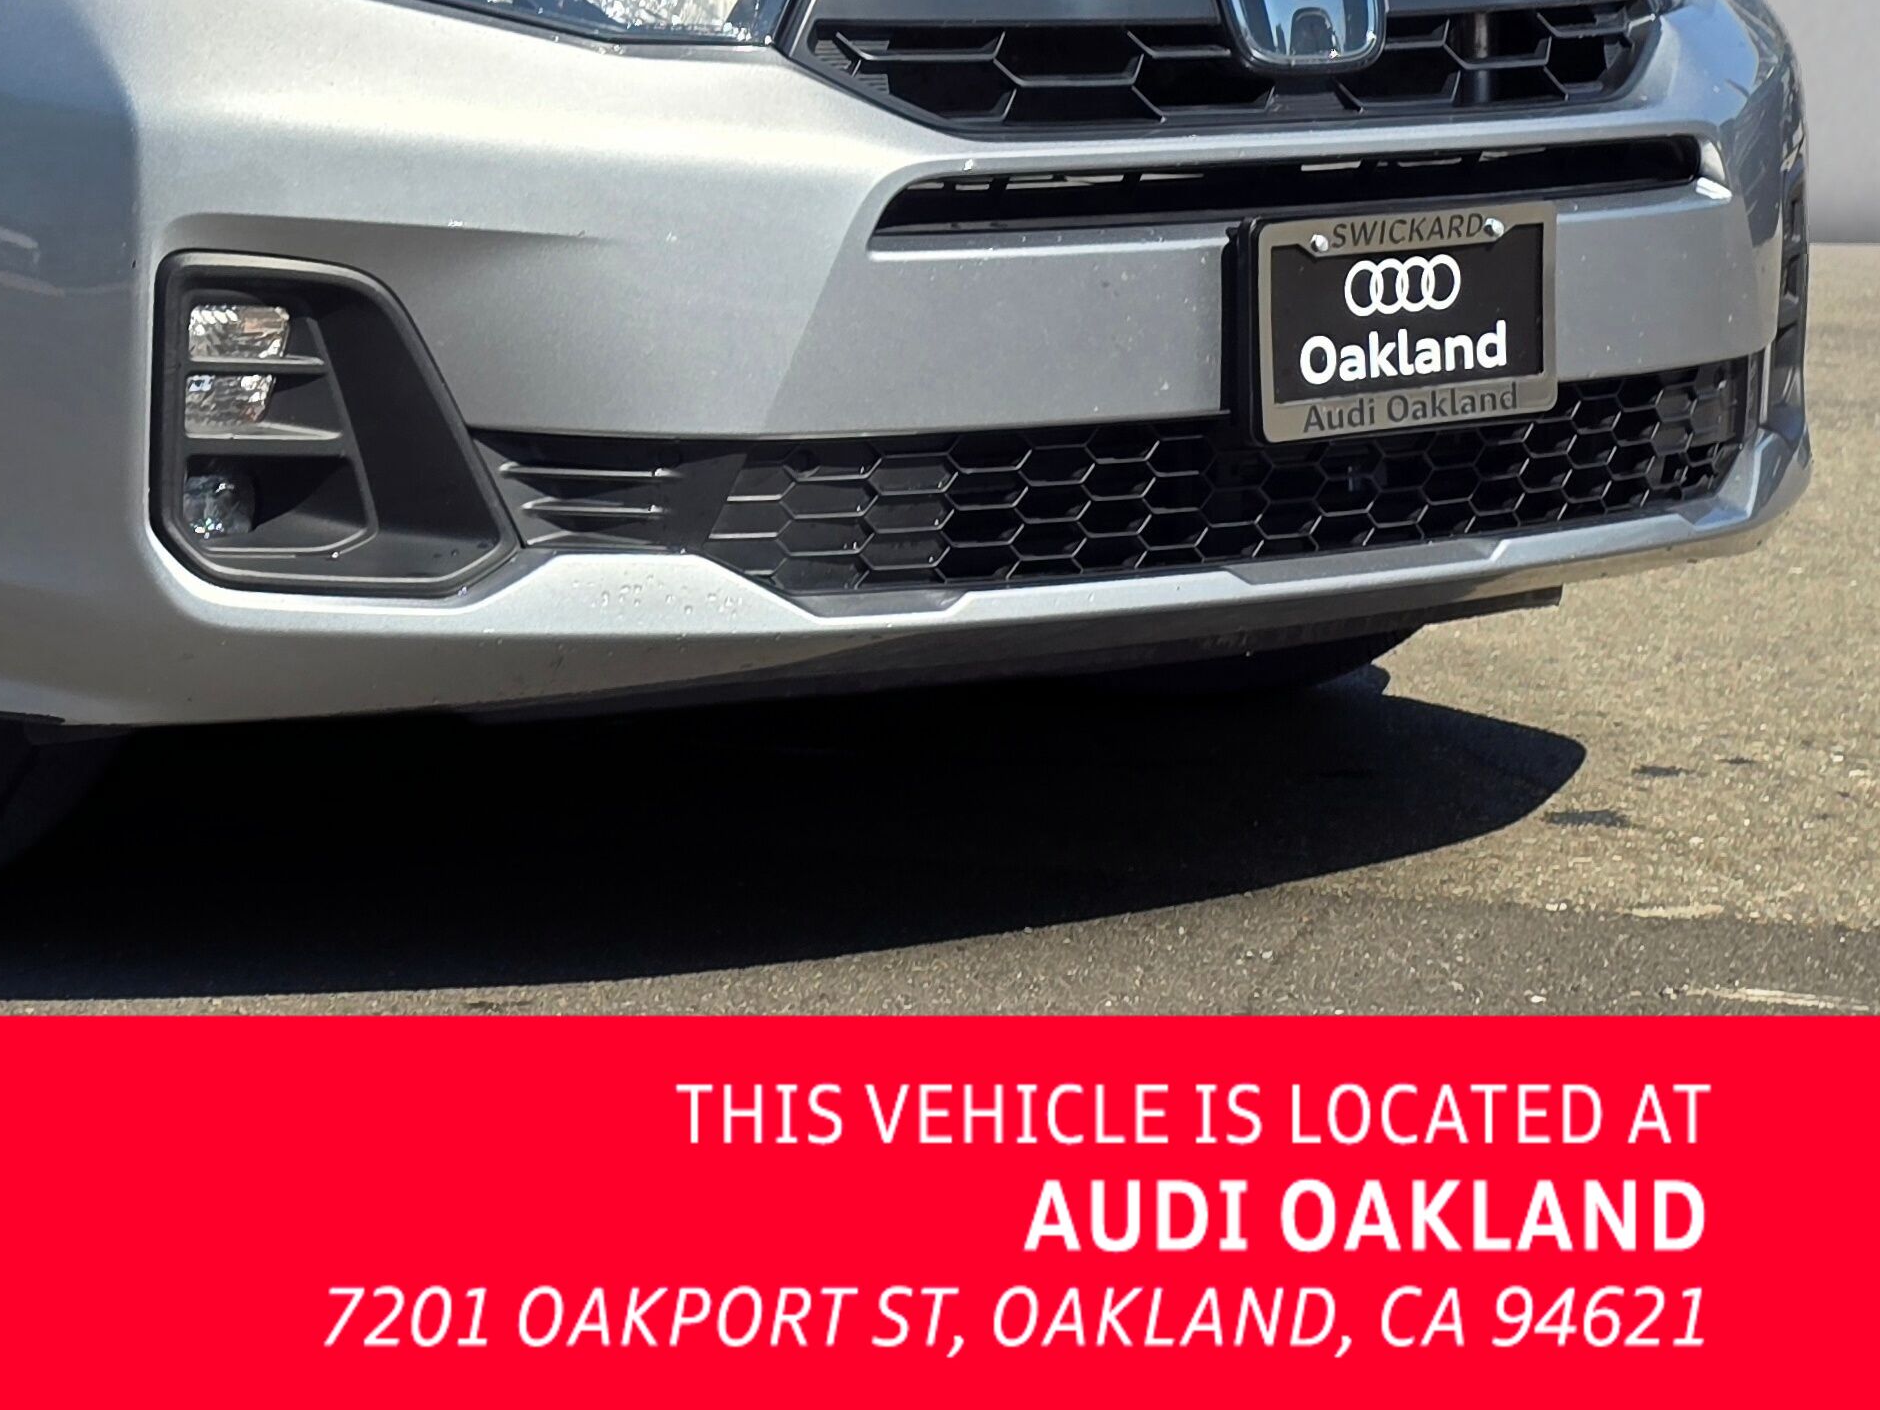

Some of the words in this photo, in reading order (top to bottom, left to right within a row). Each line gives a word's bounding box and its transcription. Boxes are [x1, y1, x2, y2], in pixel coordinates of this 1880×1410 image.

[1331, 212, 1484, 249] SWICKARD
[1299, 319, 1508, 385] Oakland
[1302, 398, 1375, 434] Audi
[1386, 381, 1519, 424] Oakland
